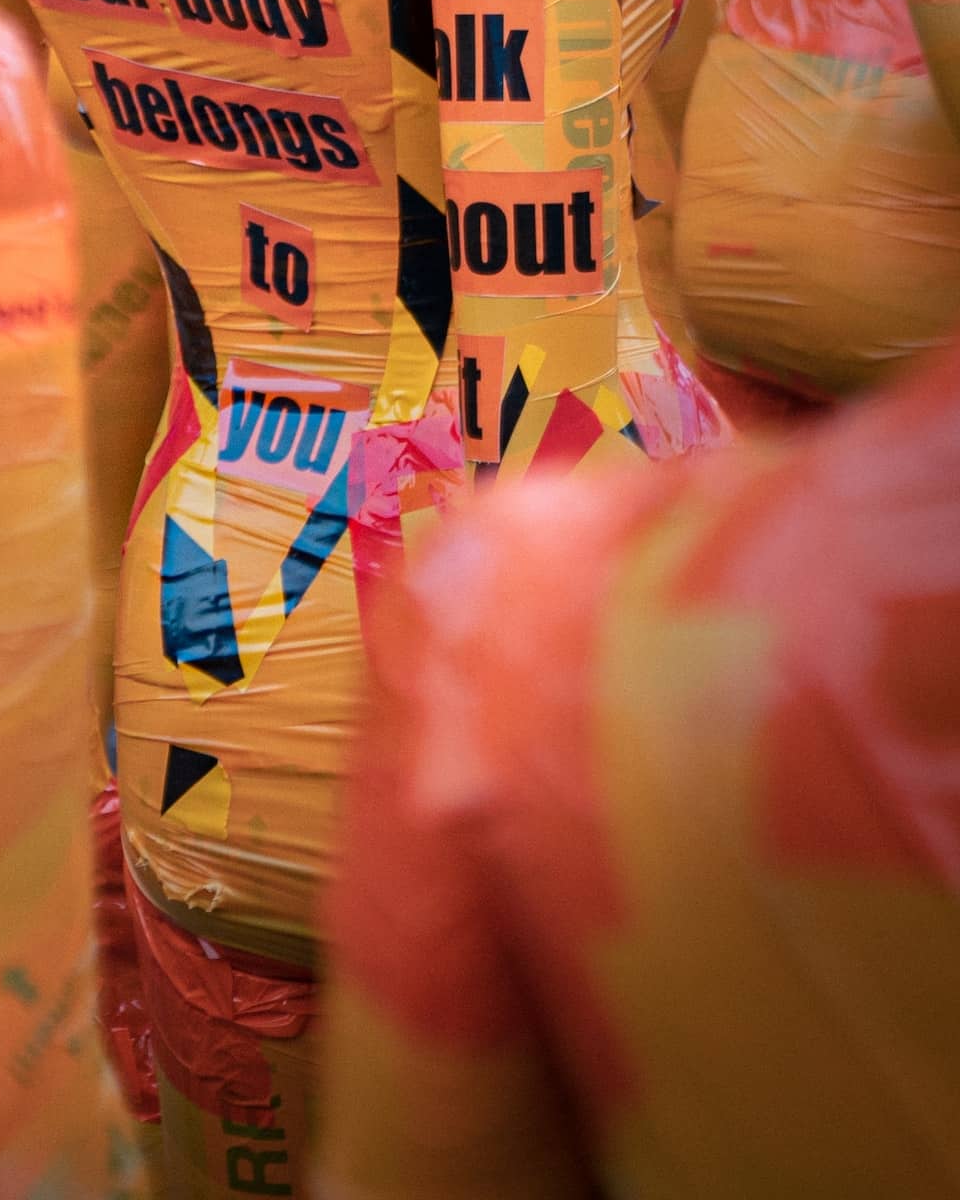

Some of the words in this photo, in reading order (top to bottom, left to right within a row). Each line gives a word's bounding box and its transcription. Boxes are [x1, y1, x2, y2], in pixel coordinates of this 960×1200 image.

[93, 61, 360, 172] belongs
[245, 221, 309, 306] to
[218, 386, 346, 475] you
